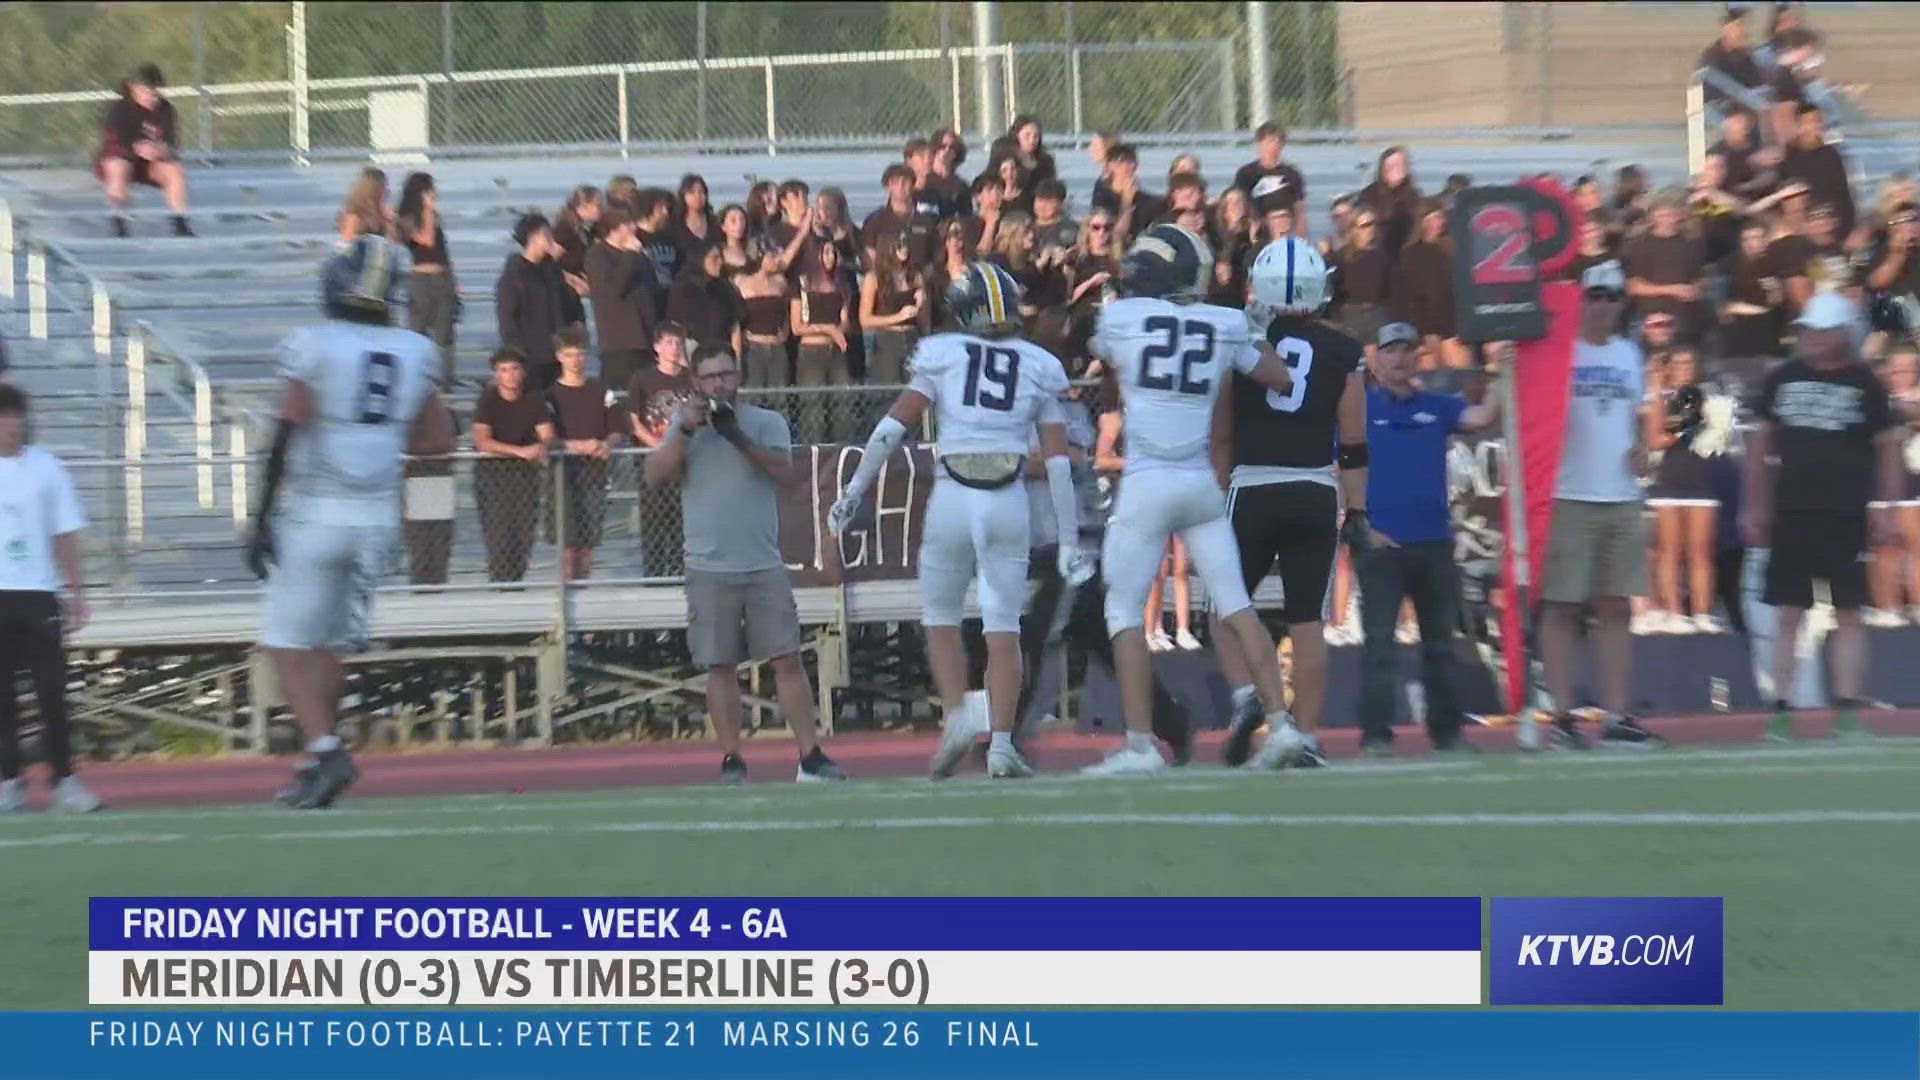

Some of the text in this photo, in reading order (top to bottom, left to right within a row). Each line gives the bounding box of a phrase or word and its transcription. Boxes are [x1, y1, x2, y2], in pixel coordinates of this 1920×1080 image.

[1469, 203, 1535, 285] 2
[963, 341, 1020, 412] 19
[1138, 315, 1215, 395] 22
[1265, 336, 1314, 413] 3
